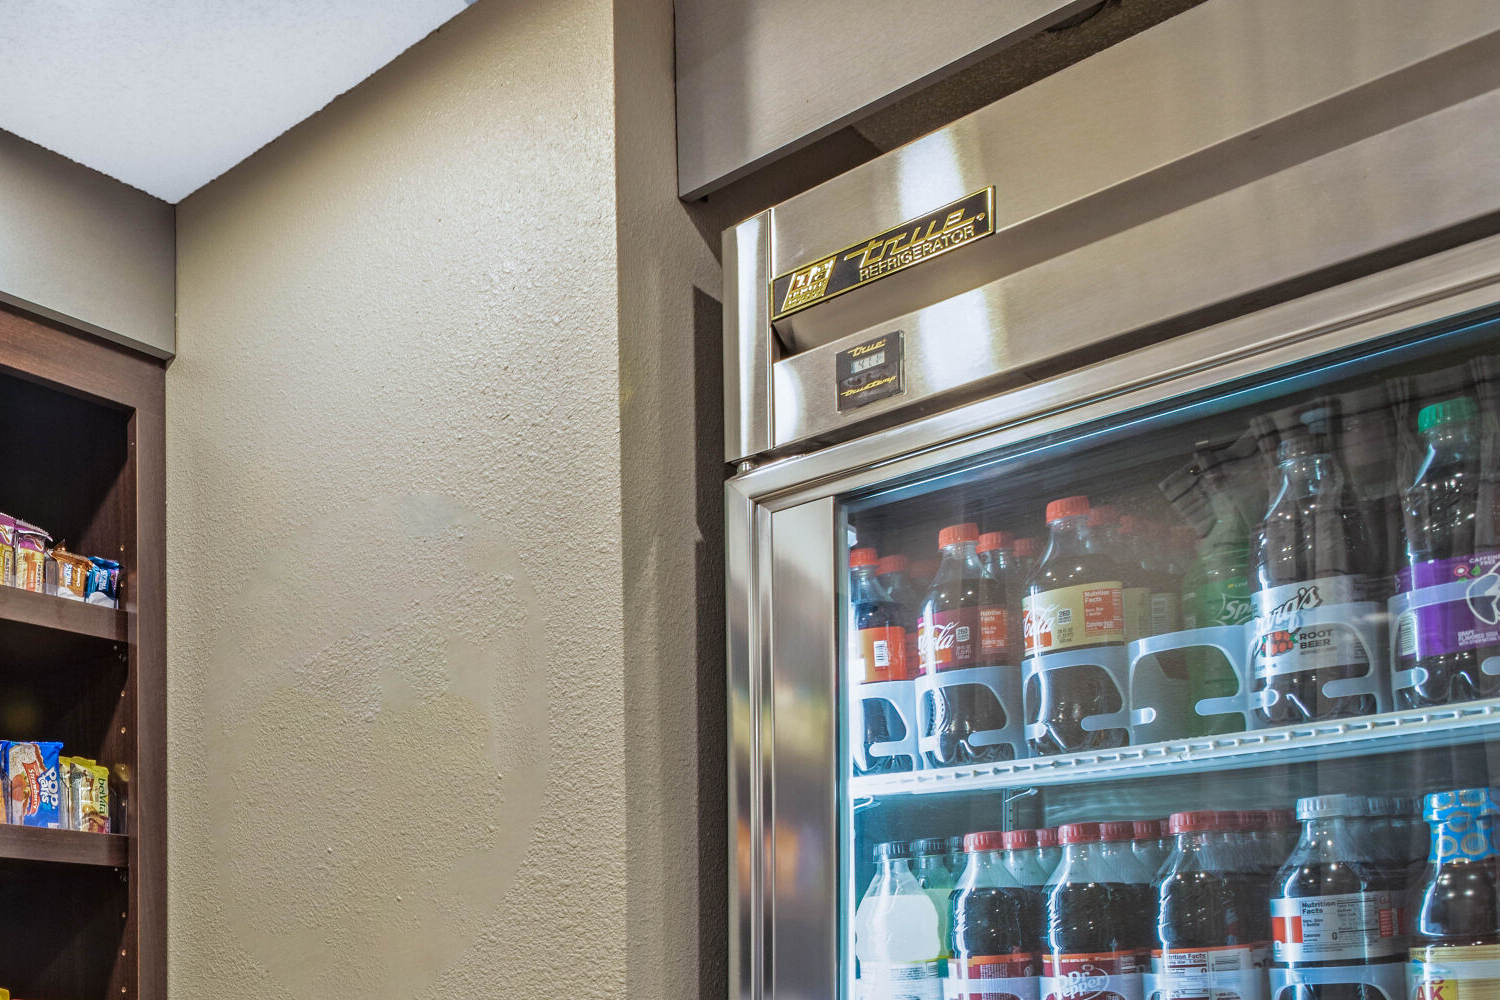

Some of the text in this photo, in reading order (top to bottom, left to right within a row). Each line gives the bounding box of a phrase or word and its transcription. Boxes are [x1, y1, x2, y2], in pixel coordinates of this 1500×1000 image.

[859, 224, 975, 282] REFRIGERATOR
[1058, 610, 1071, 618] 260
[1300, 629, 1333, 640] ROOT
[1300, 638, 1331, 649] BEER
[28, 768, 39, 809] Strawberry
[98, 778, 107, 814] belVita
[1301, 901, 1336, 909] Nutrition
[1331, 931, 1338, 941] 0
[1188, 952, 1206, 960] Facts
[1067, 971, 1090, 985] Dr
